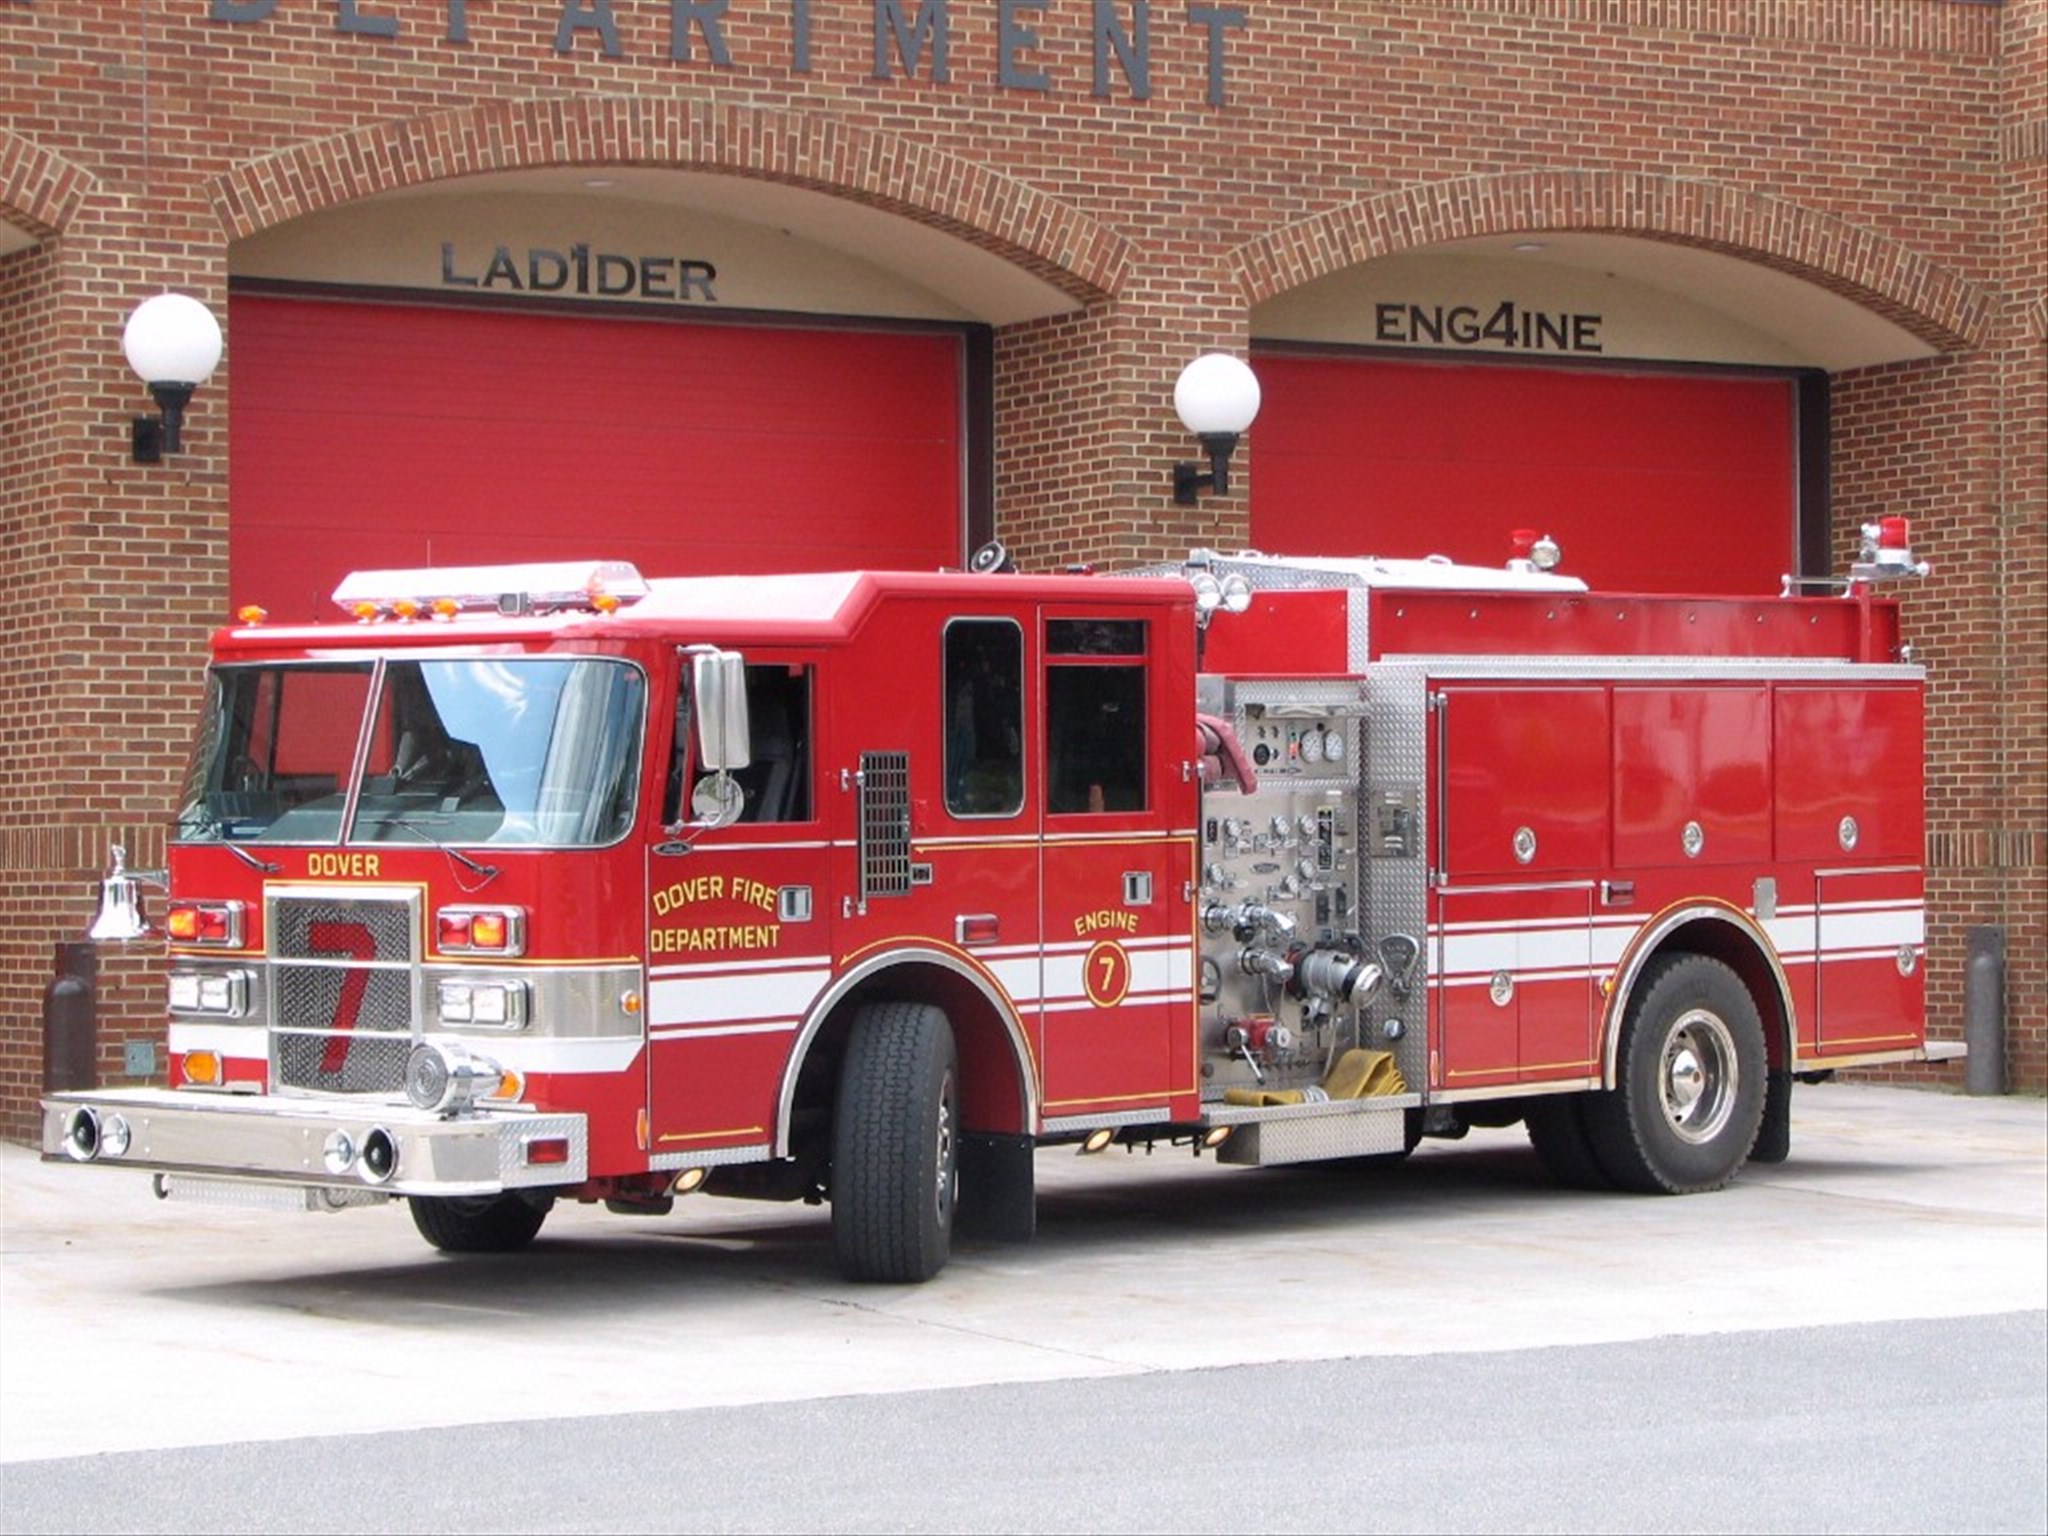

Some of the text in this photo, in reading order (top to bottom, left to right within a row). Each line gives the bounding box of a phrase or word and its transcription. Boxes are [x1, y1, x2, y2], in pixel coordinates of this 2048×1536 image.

[207, 0, 1247, 107] ARTMENT
[308, 853, 380, 877] DOVER
[653, 875, 777, 916] DOVER FIRE
[650, 924, 781, 953] DEPARTMENT
[1074, 910, 1139, 936] ENGINE
[1099, 956, 1115, 992] 7
[308, 922, 377, 1074] 7
